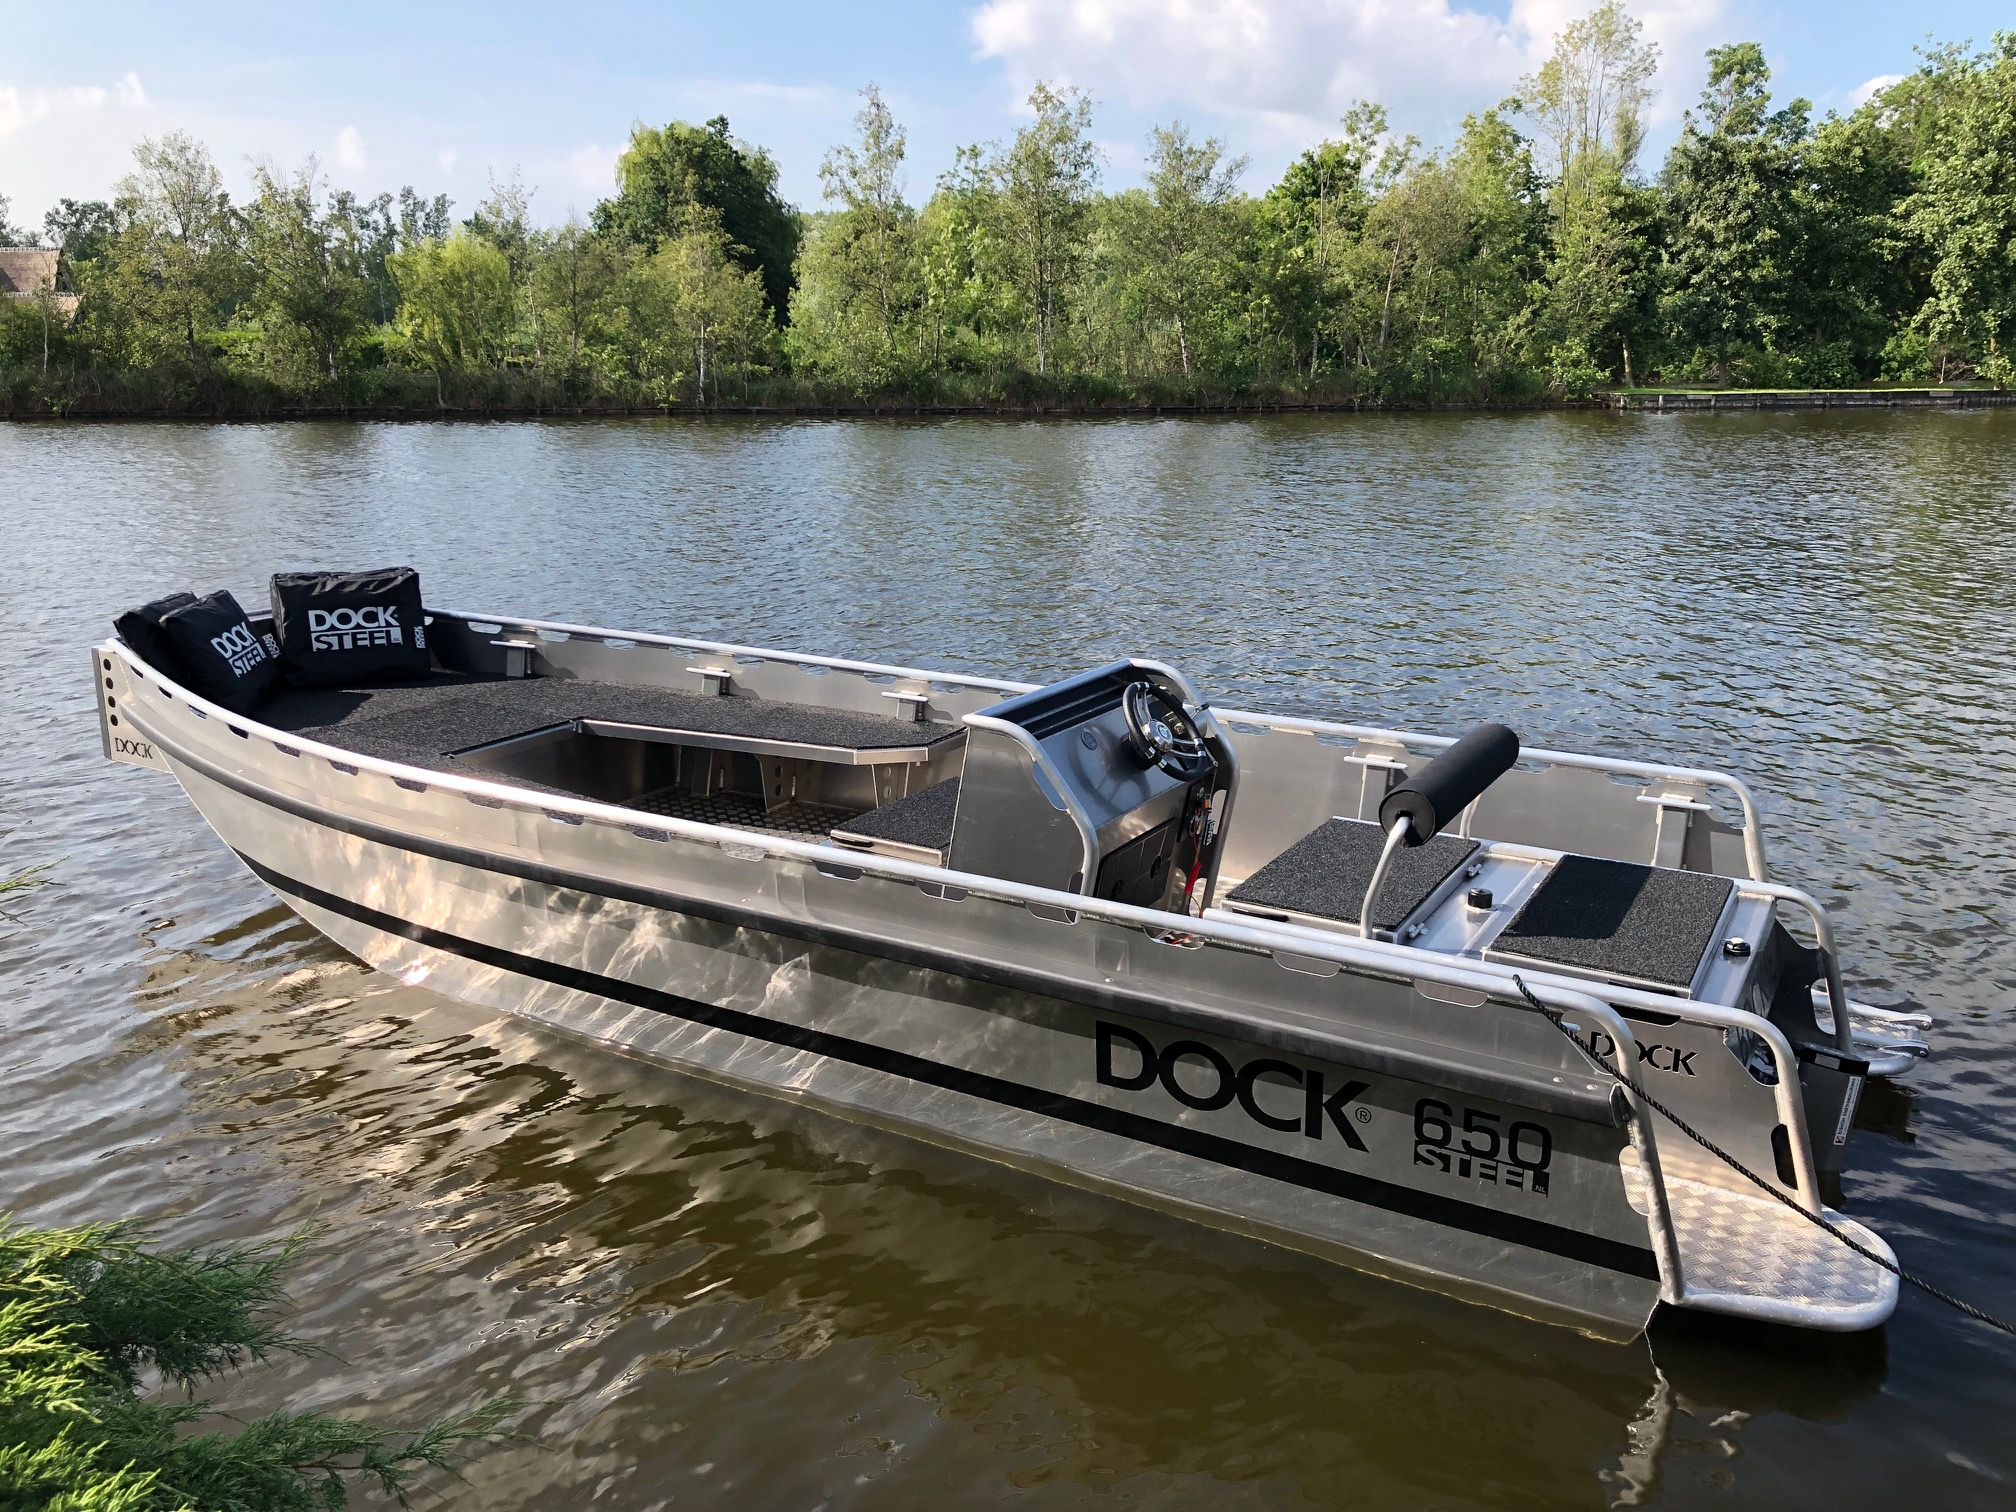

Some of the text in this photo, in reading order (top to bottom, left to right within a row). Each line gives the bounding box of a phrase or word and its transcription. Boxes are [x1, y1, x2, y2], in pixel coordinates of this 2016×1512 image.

[308, 606, 400, 632] DOCK
[211, 622, 257, 659] DOCK
[311, 627, 403, 652] STEEL
[228, 642, 267, 678] STEEL
[115, 737, 153, 760] DOCK
[1095, 1019, 1372, 1154] DOCK
[1414, 1098, 1552, 1172] 650
[1413, 1140, 1550, 1198] STEEL
